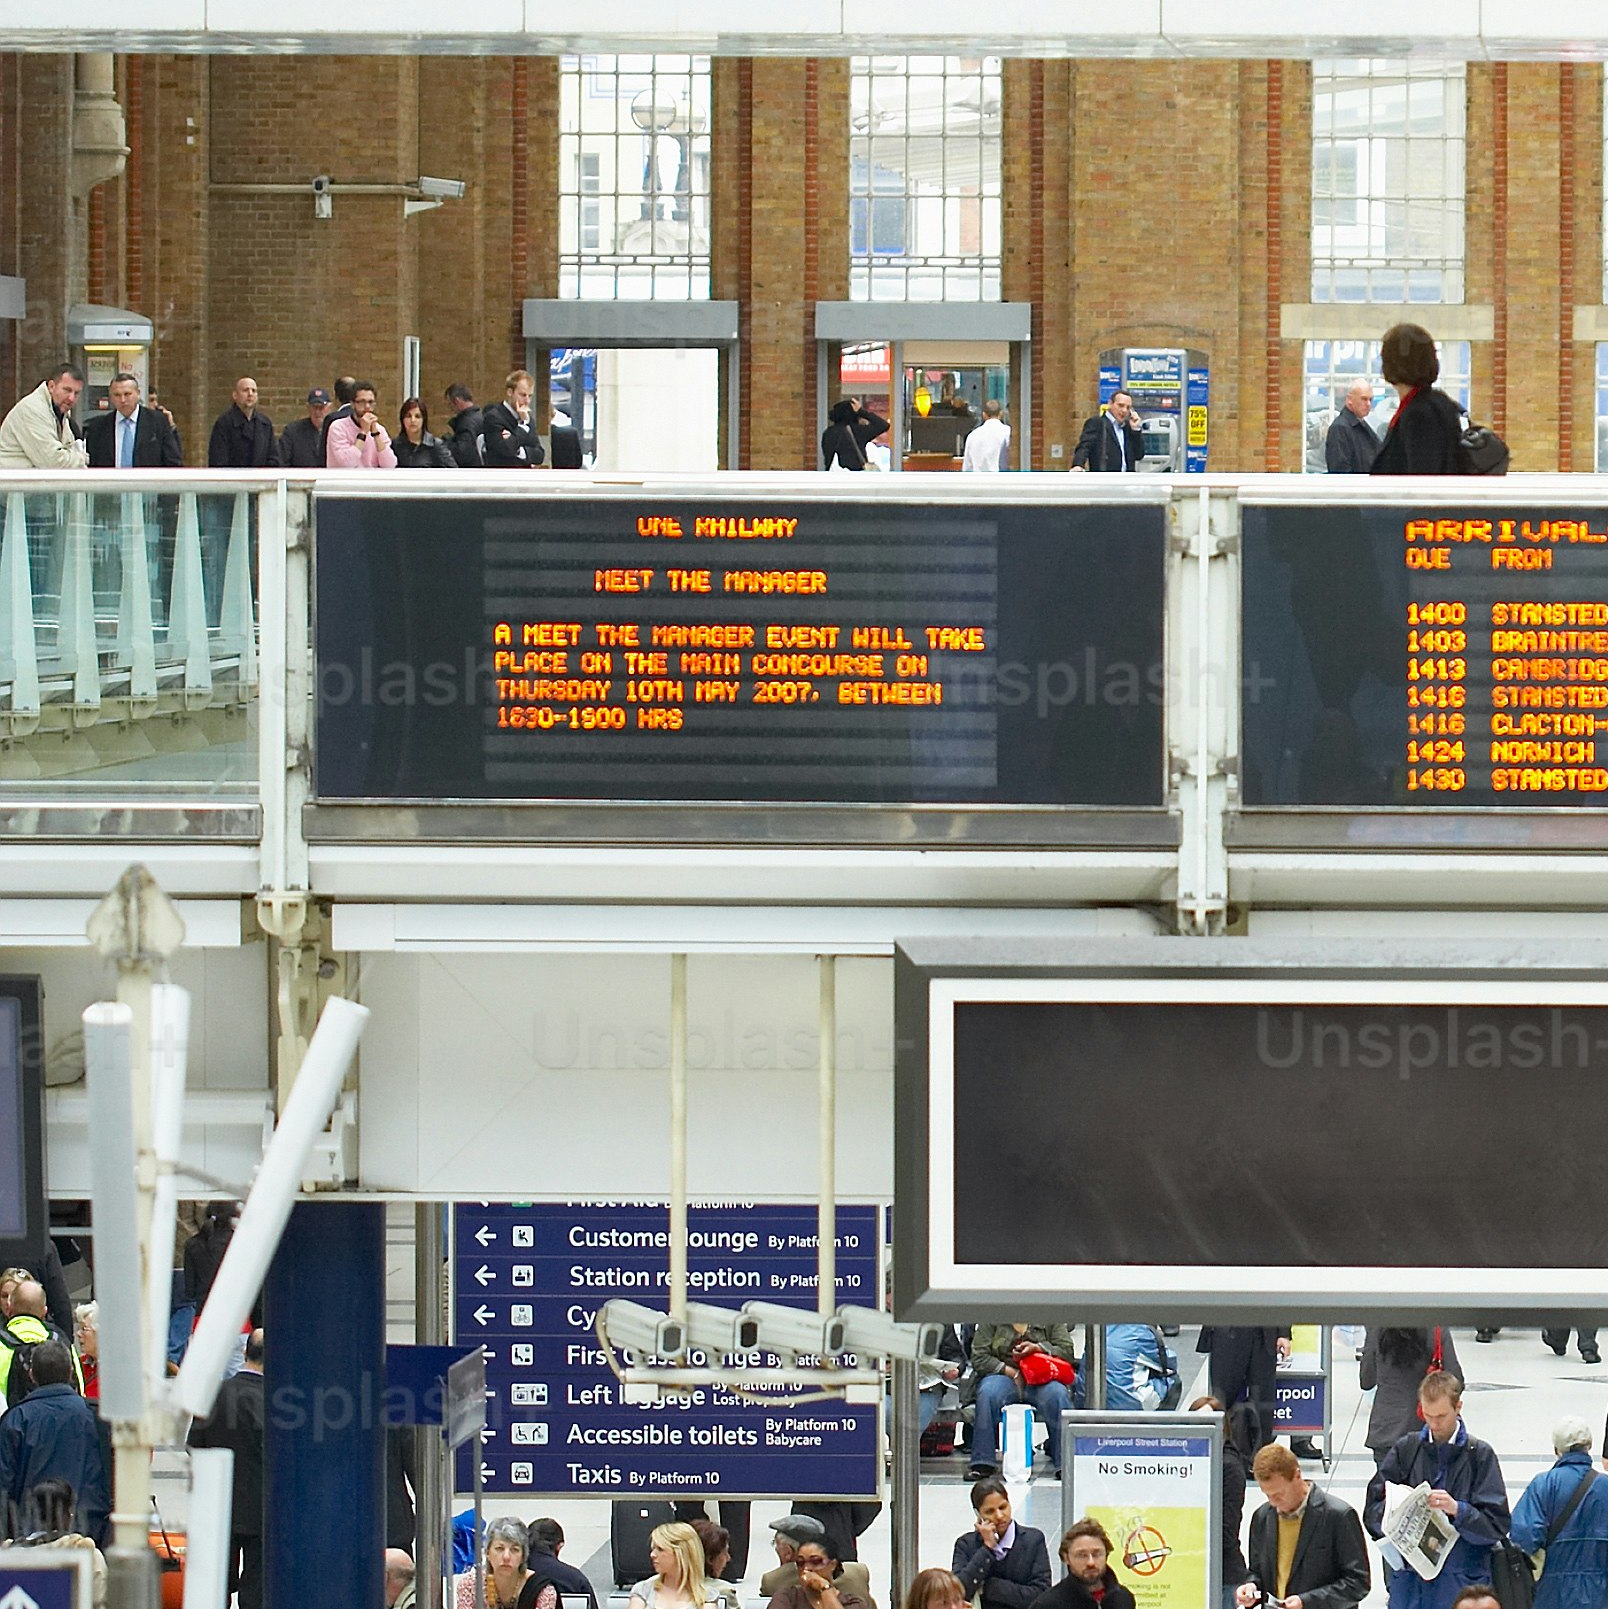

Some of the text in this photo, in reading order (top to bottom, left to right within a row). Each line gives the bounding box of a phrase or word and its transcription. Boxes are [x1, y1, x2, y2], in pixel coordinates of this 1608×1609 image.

[1491, 545, 1553, 571] FROM
[594, 568, 827, 595] MEET THE MANAGER
[1407, 601, 1467, 626] 1400
[521, 622, 582, 648] MEET
[595, 623, 640, 648] THE
[650, 624, 755, 649] MANAGER
[764, 624, 840, 649] EVENT
[851, 626, 912, 651] WILL
[924, 627, 985, 651] TAKE
[579, 651, 612, 675] ON
[623, 651, 668, 676] THE
[679, 652, 741, 676] MAIN
[751, 653, 884, 678] CONCOURSE
[894, 653, 928, 678] ON
[693, 680, 740, 703] MAY
[837, 681, 942, 705] BETWEEN
[768, 1236, 786, 1250] By
[844, 1235, 859, 1248] 10
[569, 1265, 651, 1287] Station
[770, 1275, 788, 1290] By
[846, 1275, 861, 1287] 10
[686, 1347, 761, 1370] longe
[842, 1353, 858, 1366] 10
[566, 1384, 613, 1405] Left
[713, 1394, 741, 1406] Lost
[566, 1423, 758, 1446] Accessible toilets
[765, 1418, 857, 1433] By Platform 10
[765, 1433, 823, 1448] Babycare
[1135, 1438, 1161, 1447] Street
[1162, 1438, 1188, 1448] Station
[566, 1463, 720, 1487] Taxis By Platform 10
[1098, 1462, 1194, 1478] No Smoking!
